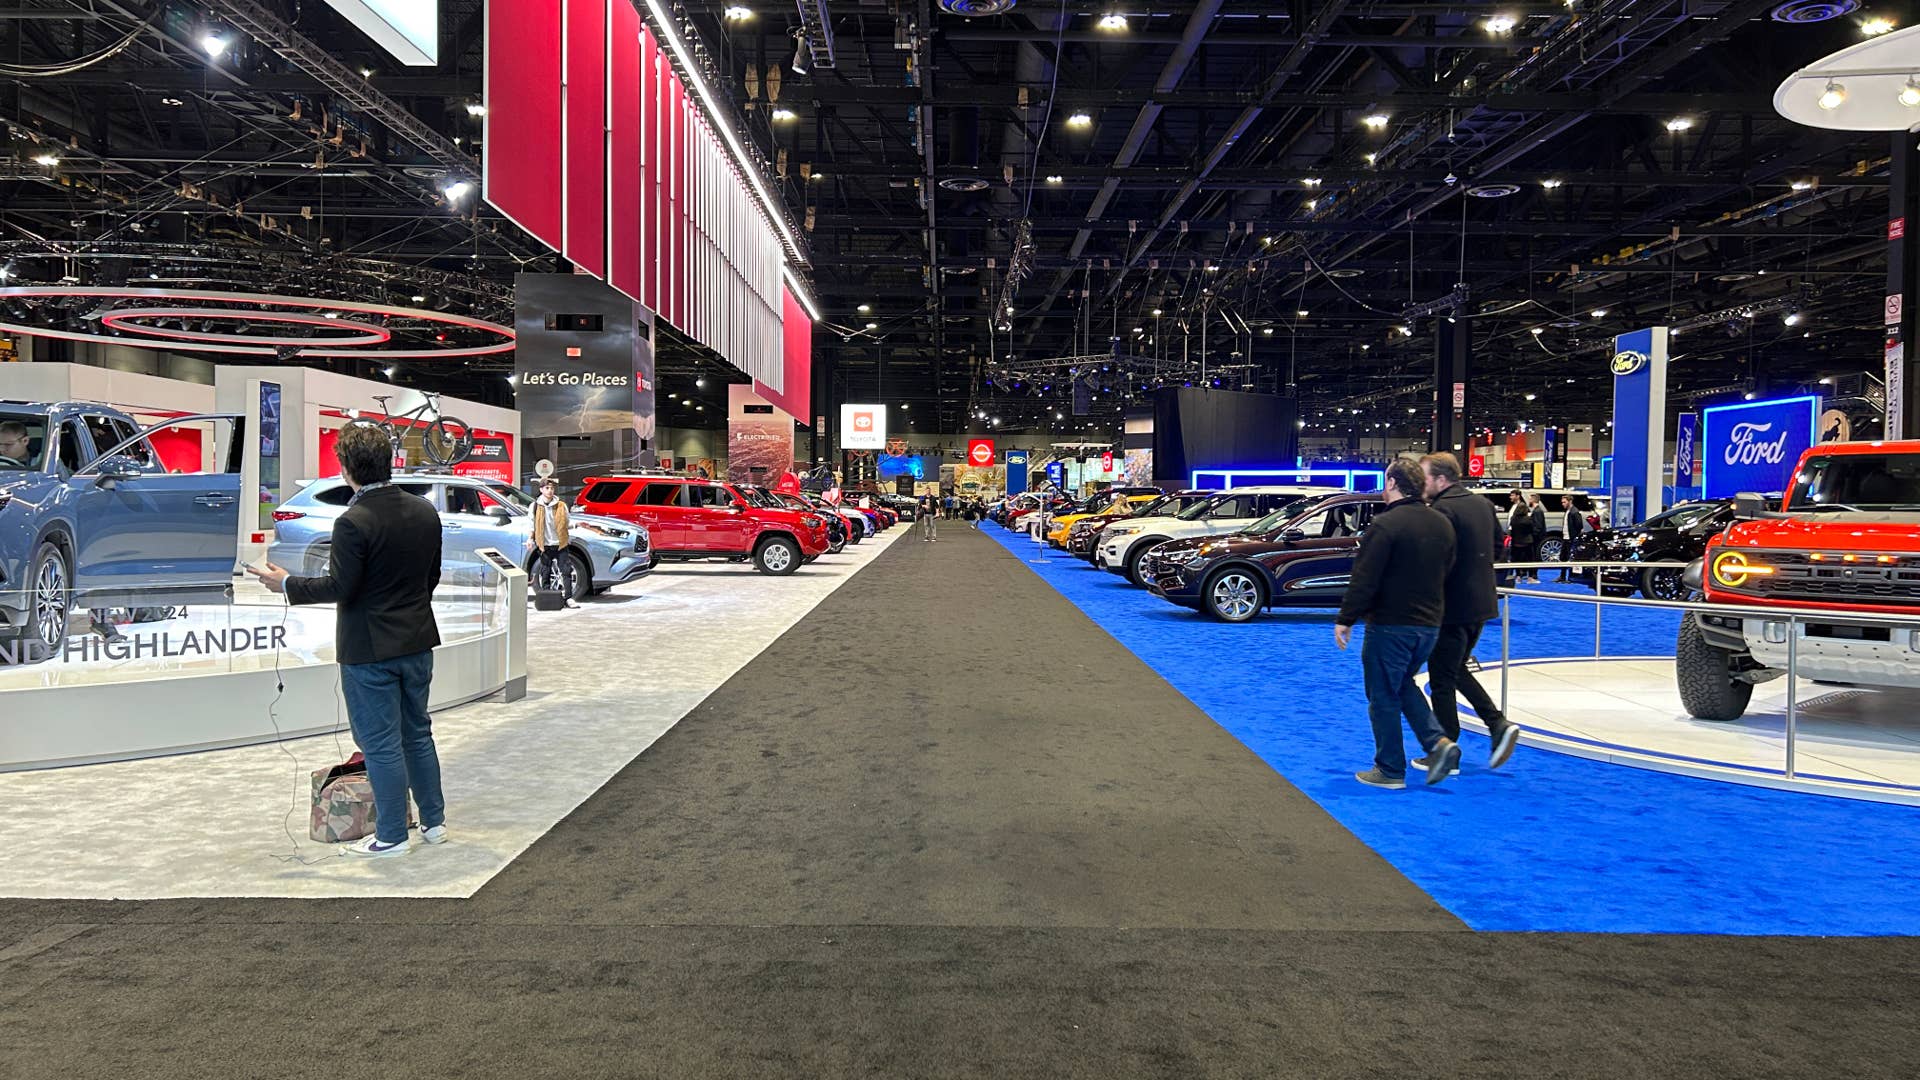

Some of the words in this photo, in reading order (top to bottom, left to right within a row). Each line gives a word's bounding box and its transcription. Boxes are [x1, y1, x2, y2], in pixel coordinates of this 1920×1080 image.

[1613, 354, 1635, 371] Ford
[557, 372, 579, 385] Go
[582, 372, 627, 386] Places
[1679, 426, 1692, 476] Ford
[1724, 422, 1788, 466] Ford
[87, 606, 138, 624] NEW
[63, 625, 288, 664] HIGHLANDER
